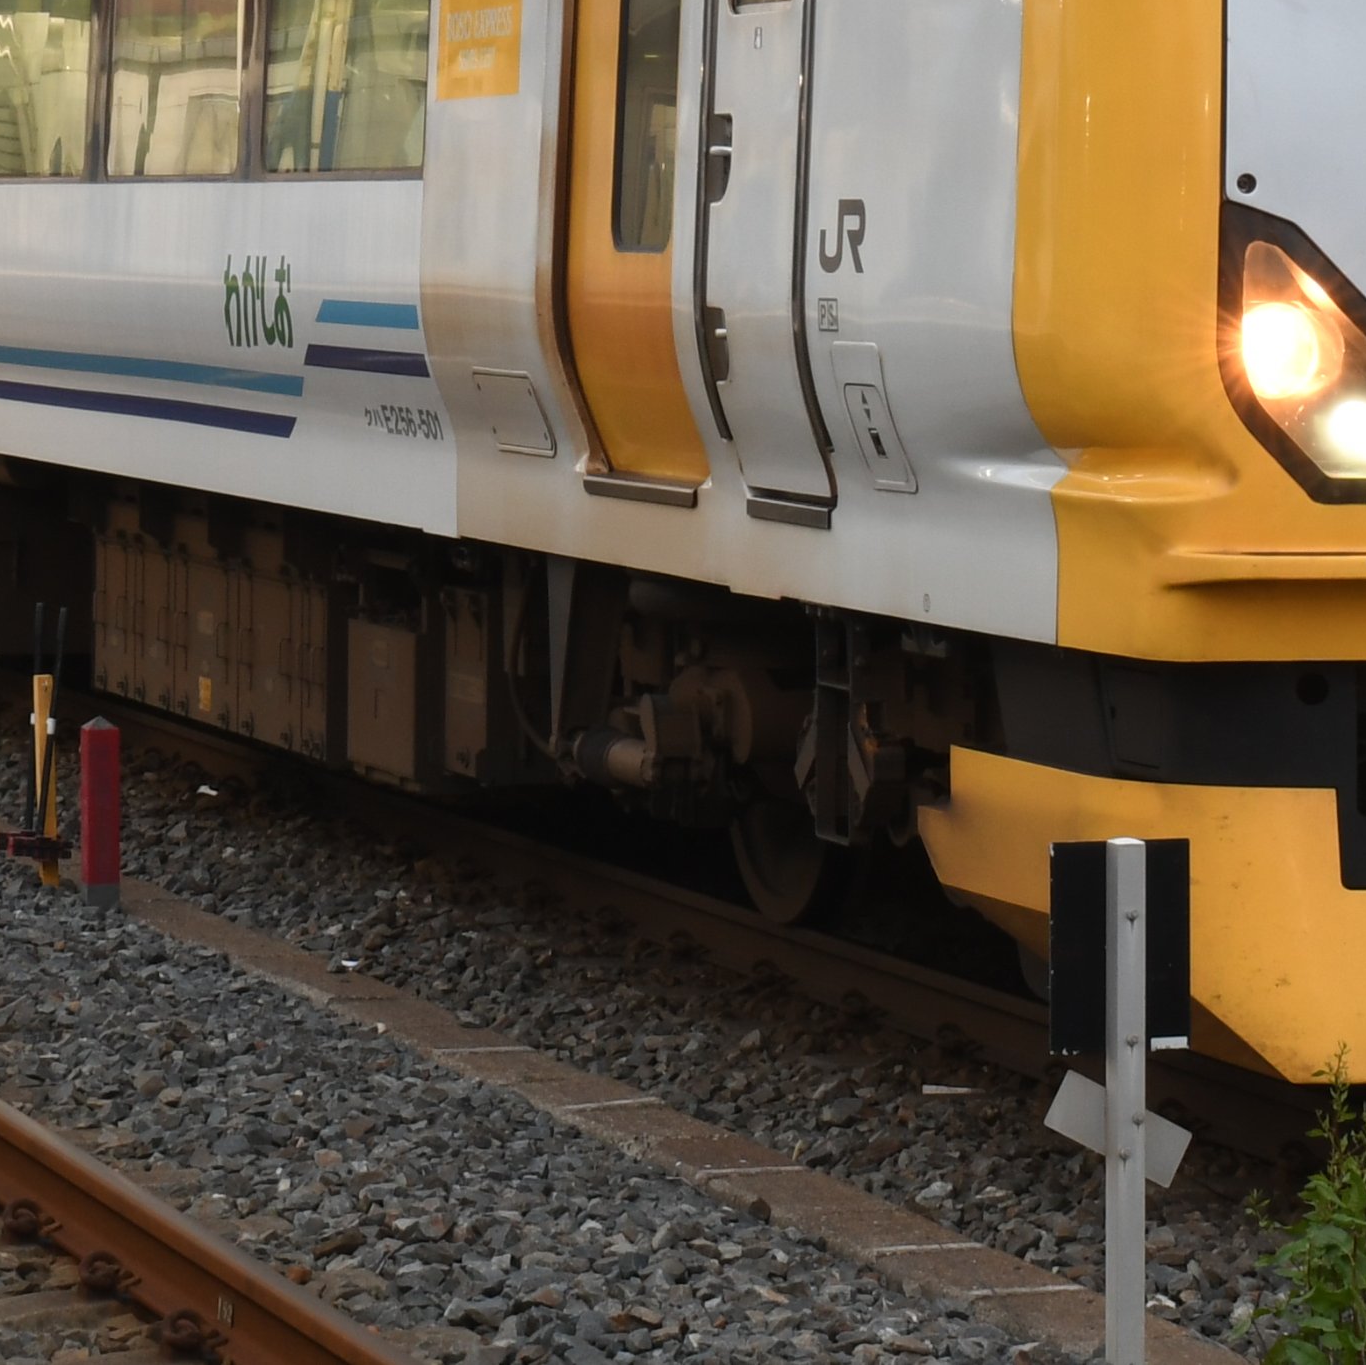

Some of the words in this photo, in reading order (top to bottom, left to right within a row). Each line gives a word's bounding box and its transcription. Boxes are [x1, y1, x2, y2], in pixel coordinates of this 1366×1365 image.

[819, 198, 867, 274] JR
[224, 254, 294, 348] わかしお
[364, 404, 444, 440] クハE256-501
